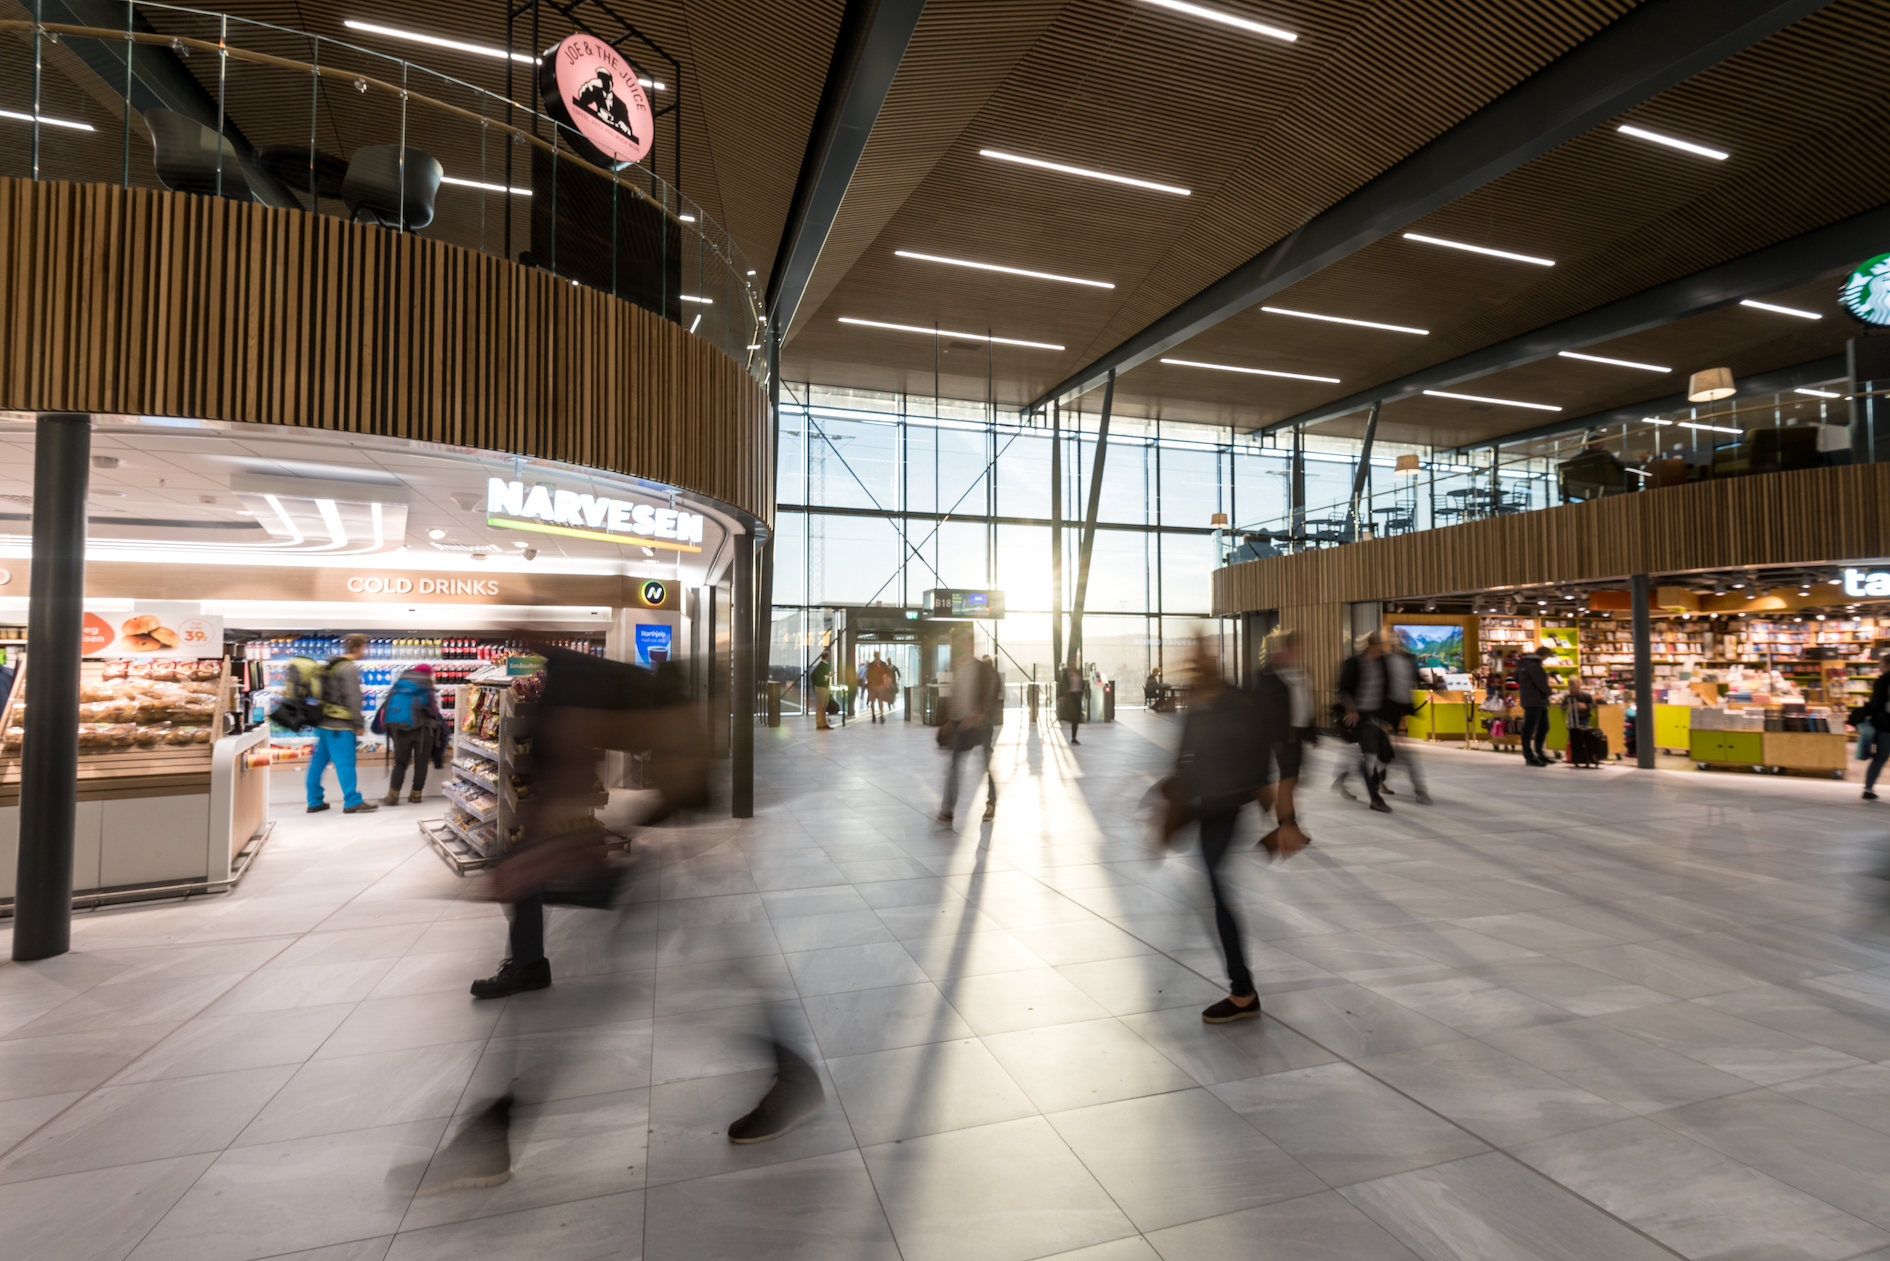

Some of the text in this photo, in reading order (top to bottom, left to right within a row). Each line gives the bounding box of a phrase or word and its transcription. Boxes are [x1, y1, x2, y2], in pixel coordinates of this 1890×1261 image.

[564, 41, 647, 113] JOE & THE JUICE
[487, 477, 704, 543] NARVESEN
[347, 576, 499, 596] COLD DRINKS
[1844, 568, 1890, 597] ta
[935, 598, 952, 608] B18
